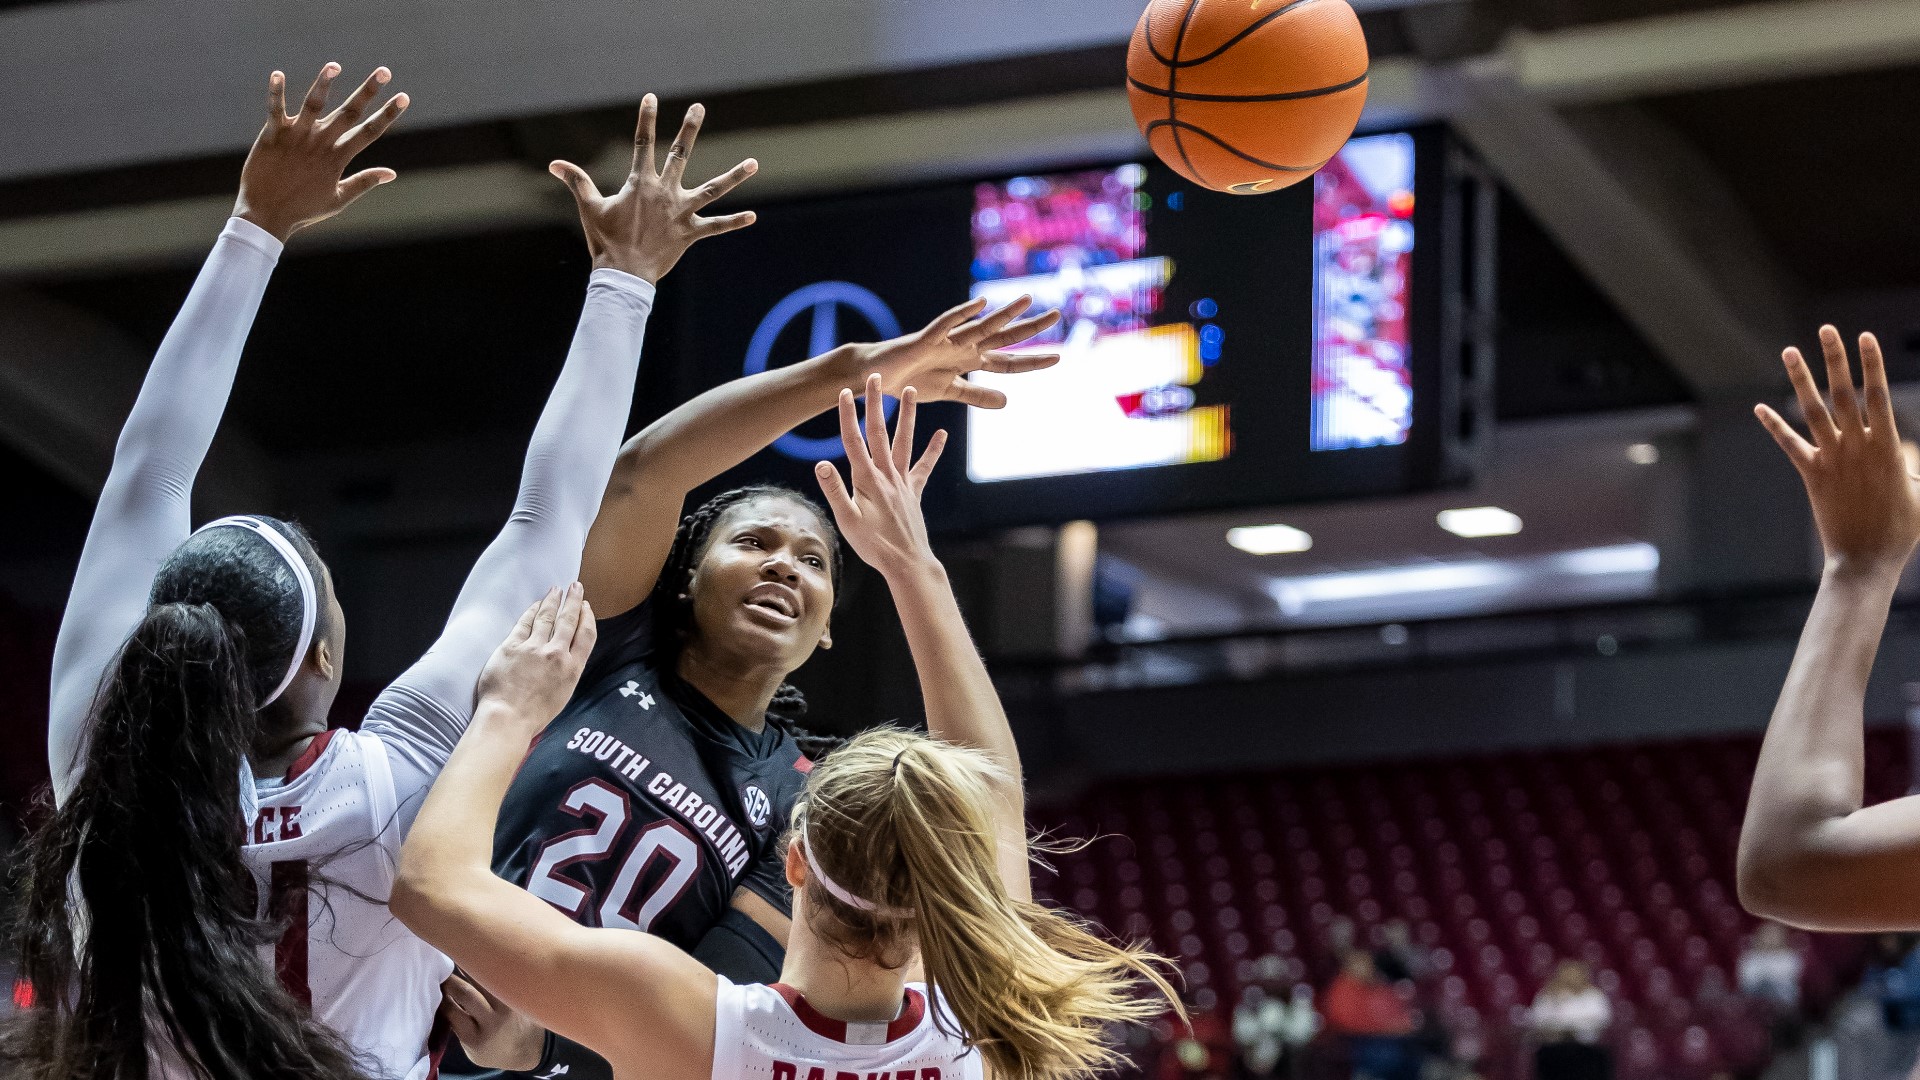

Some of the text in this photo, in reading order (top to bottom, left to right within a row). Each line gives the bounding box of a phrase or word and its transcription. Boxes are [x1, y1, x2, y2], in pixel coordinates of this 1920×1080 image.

[527, 777, 703, 933] 20
[566, 727, 750, 879] SOUTH CAROLINA
[744, 786, 770, 826] SEC
